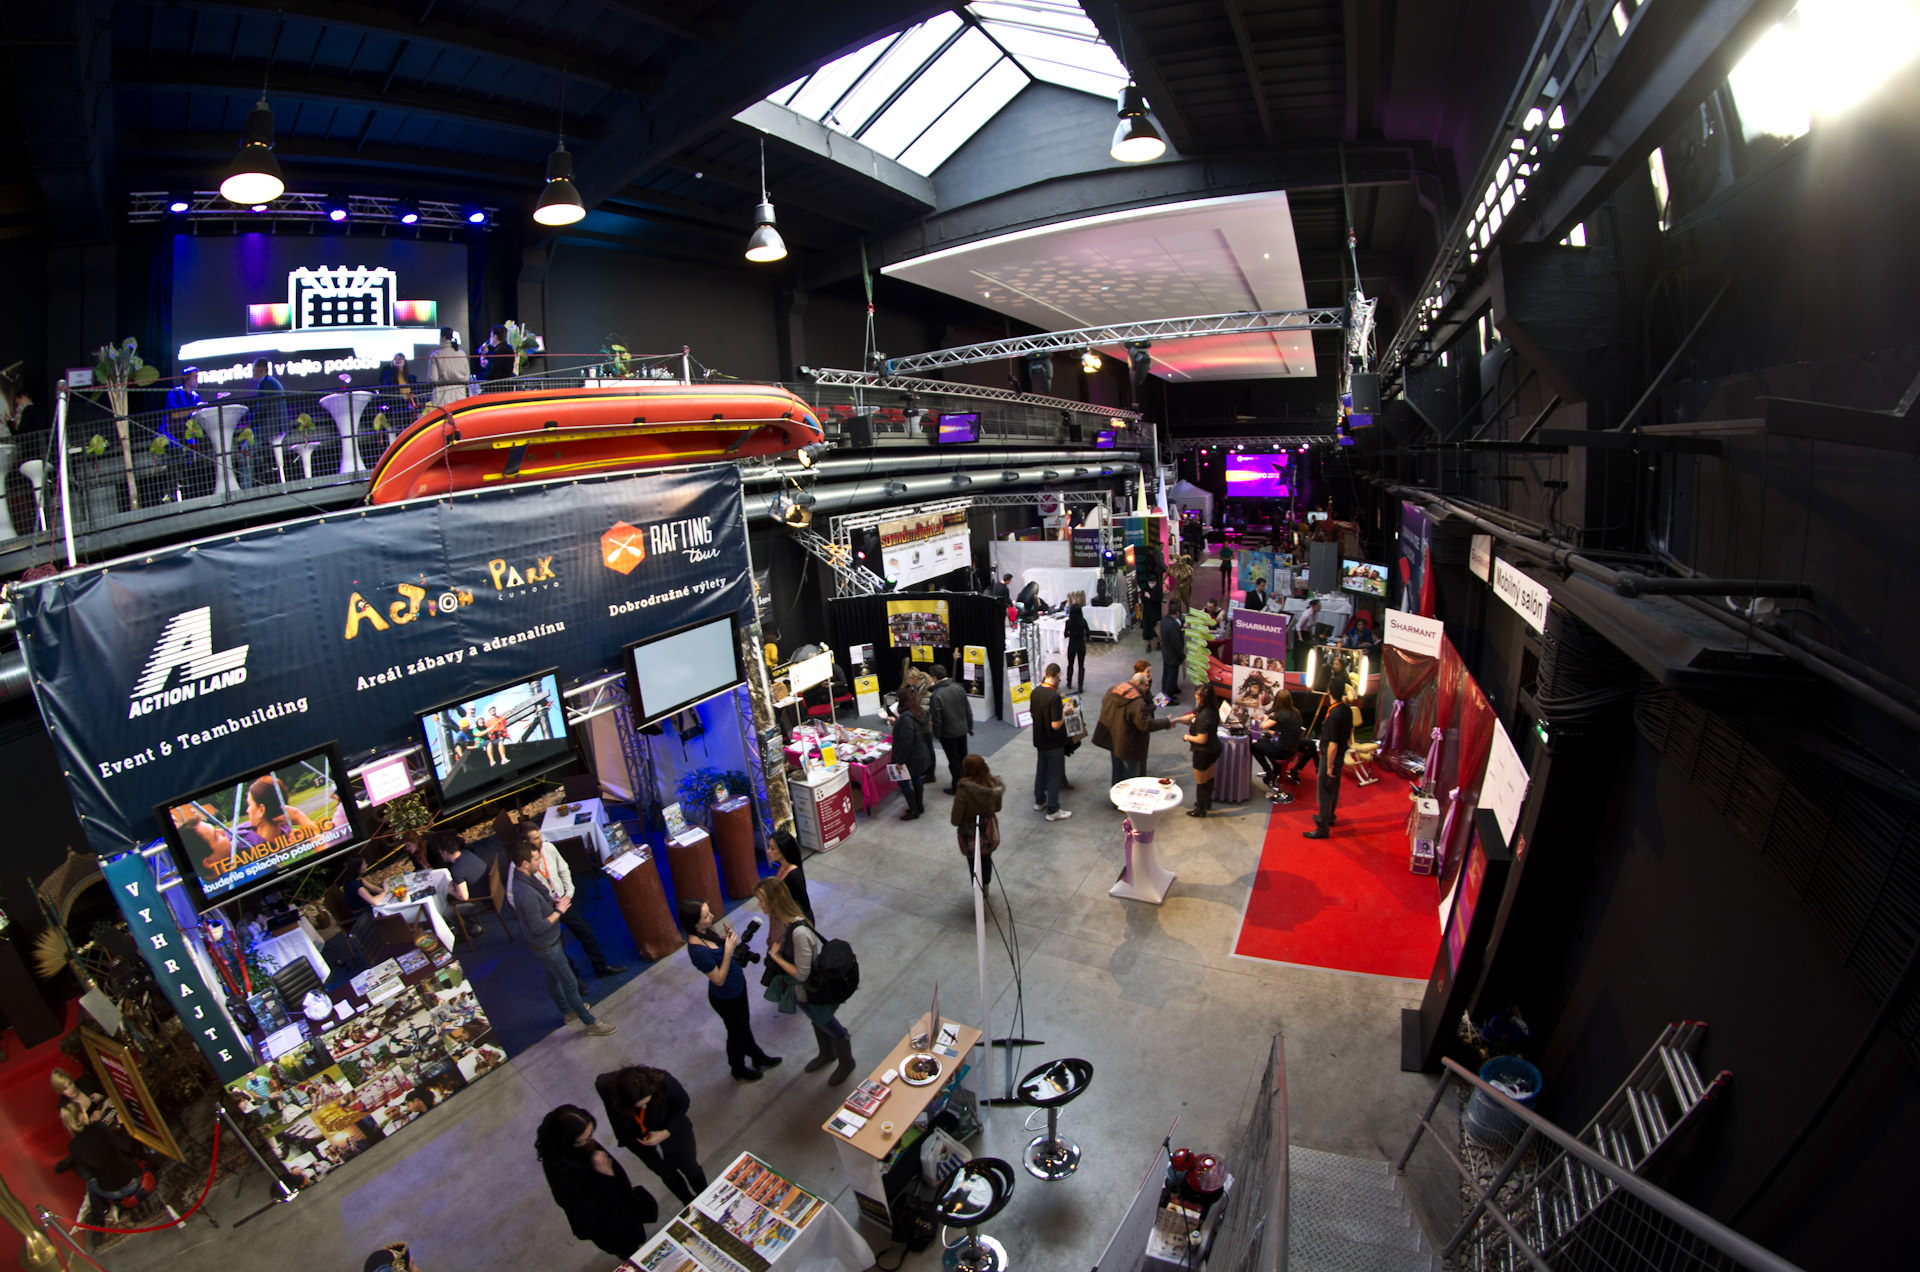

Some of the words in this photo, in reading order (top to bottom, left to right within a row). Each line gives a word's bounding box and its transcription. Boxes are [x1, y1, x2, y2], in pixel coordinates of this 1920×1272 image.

[650, 515, 713, 555] RAFTING
[681, 547, 721, 563] tour
[608, 585, 690, 617] Dobrodružné
[692, 577, 727, 594] výlety
[1496, 565, 1521, 607] Mobilný
[1521, 589, 1543, 621] salón
[1390, 619, 1437, 639] SHARMANT
[356, 665, 403, 691] Areál
[407, 649, 465, 676] zábavy
[468, 645, 478, 657] a
[483, 621, 566, 652] adrenalínu
[128, 682, 196, 720] ACTION
[199, 667, 247, 696] LAND
[98, 747, 156, 778] Event
[159, 741, 173, 756] &
[177, 696, 309, 750] Teambuilding
[209, 816, 335, 876] TEAMBUILDING
[203, 871, 245, 894] budenie
[245, 852, 290, 876] spiaceho
[125, 881, 232, 1063] VYHRAJTE
